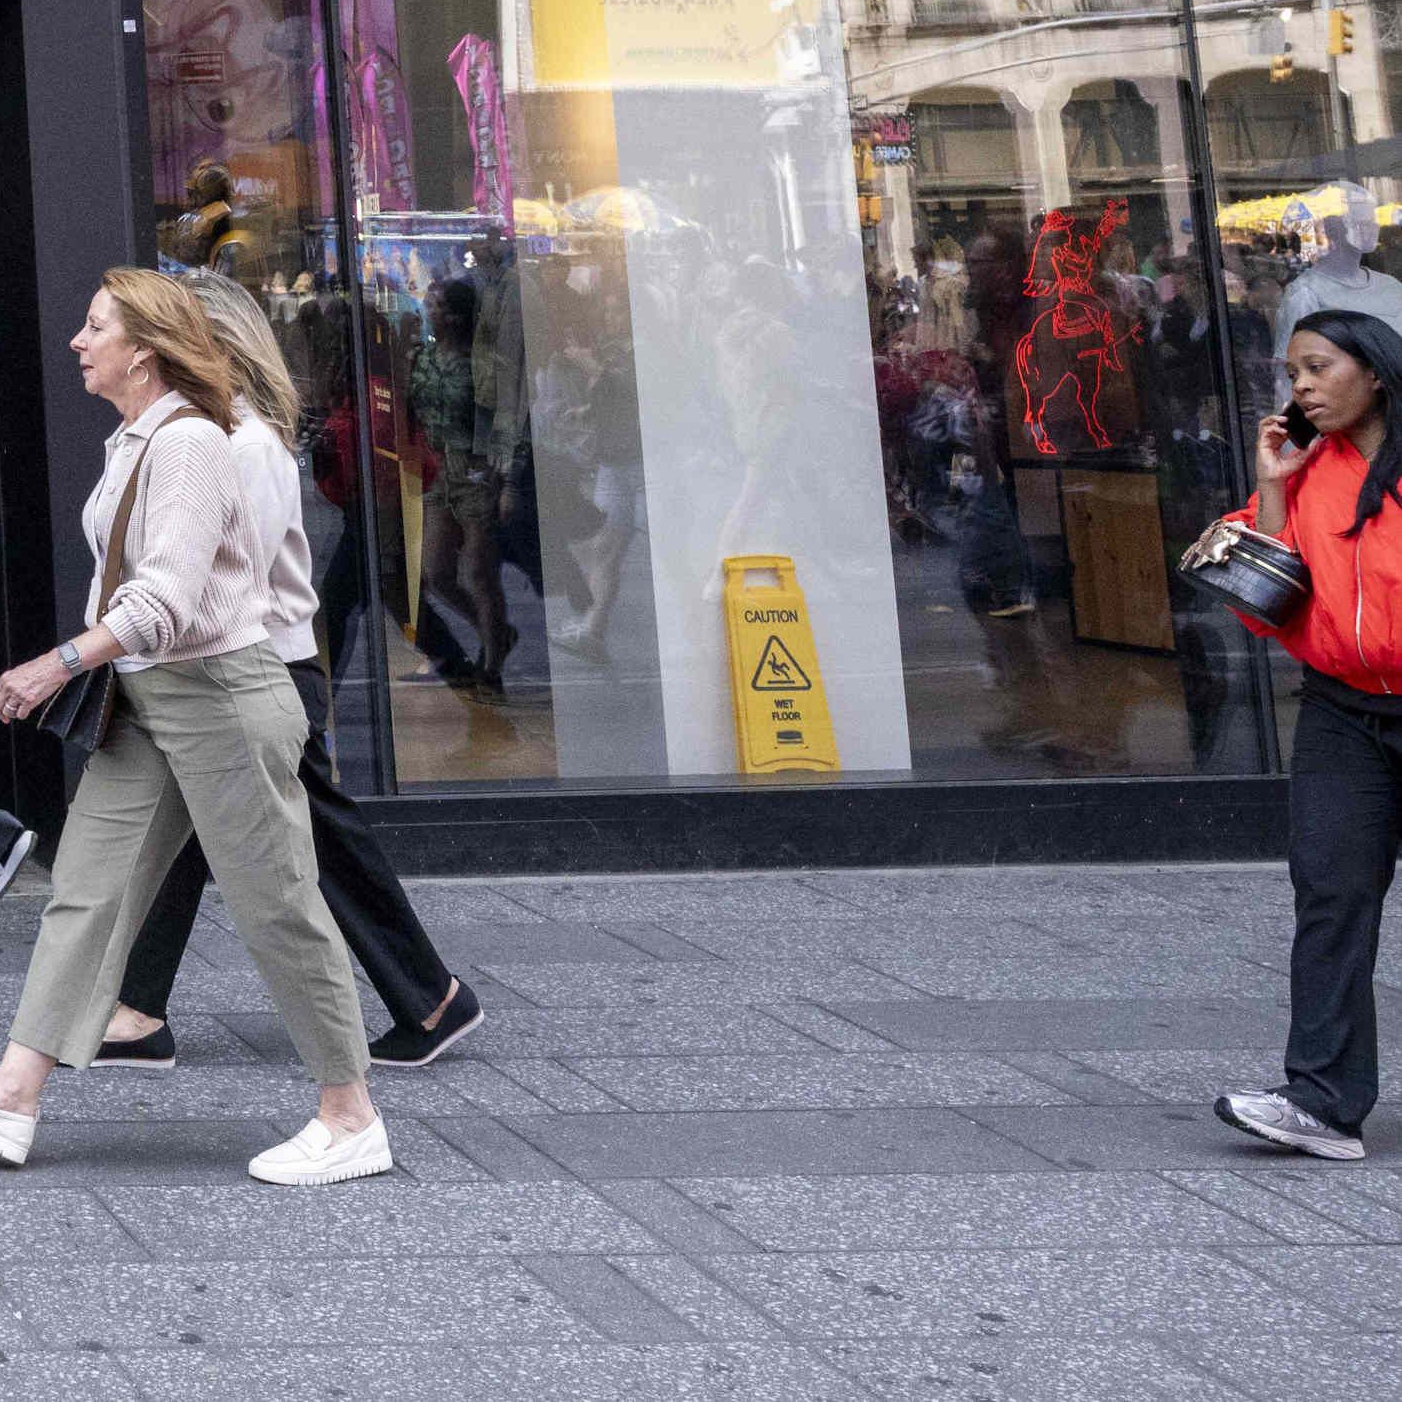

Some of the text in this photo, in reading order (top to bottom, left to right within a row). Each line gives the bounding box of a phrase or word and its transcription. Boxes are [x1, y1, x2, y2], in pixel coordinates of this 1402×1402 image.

[744, 610, 799, 623] CAUTION
[773, 698, 794, 709] WET
[771, 712, 801, 721] FLOOR
